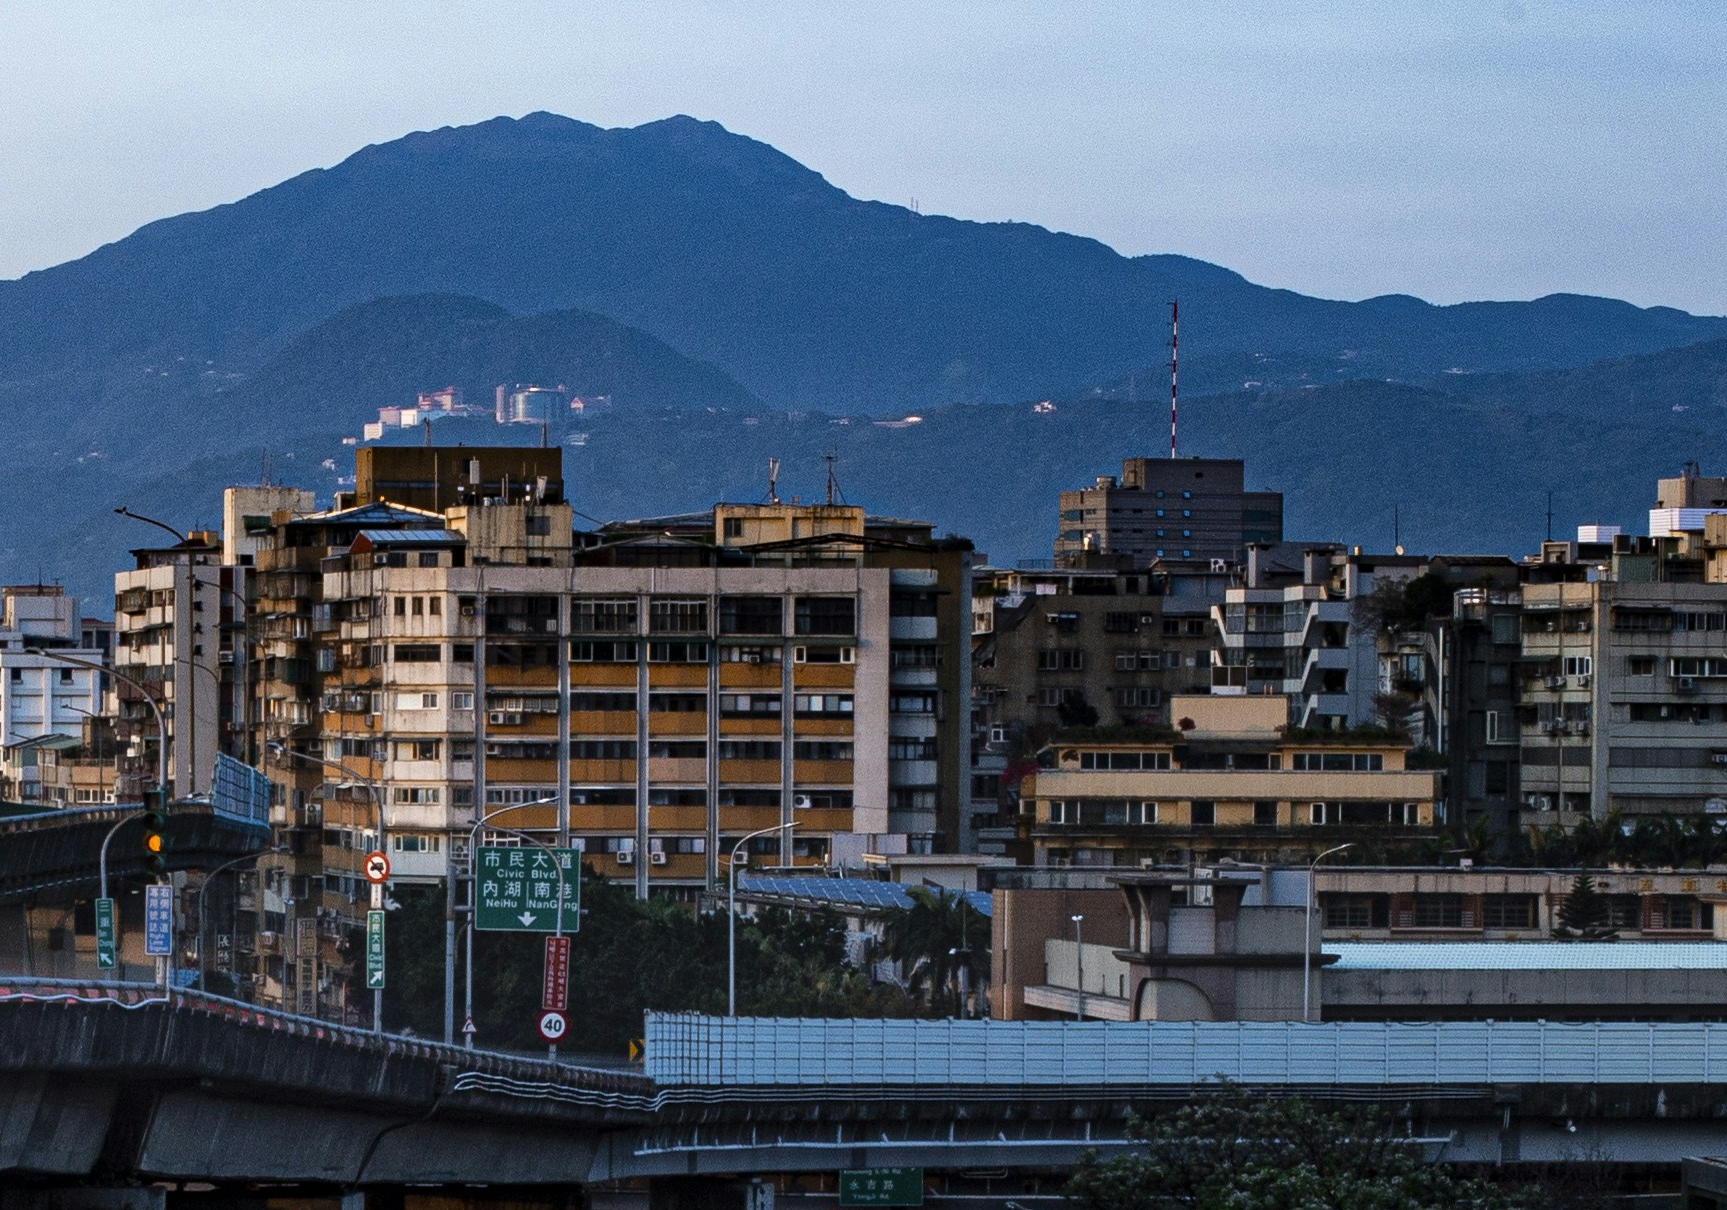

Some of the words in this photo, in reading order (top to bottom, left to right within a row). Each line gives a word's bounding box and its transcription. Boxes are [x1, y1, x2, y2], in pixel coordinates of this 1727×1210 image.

[485, 850, 572, 869] 市民大道
[497, 869, 524, 878] Civic
[534, 881, 572, 899] 南港
[160, 888, 169, 933] 右側車道
[485, 899, 517, 908] NeiHu
[528, 900, 578, 911] NanGng
[544, 1018, 562, 1032] 40
